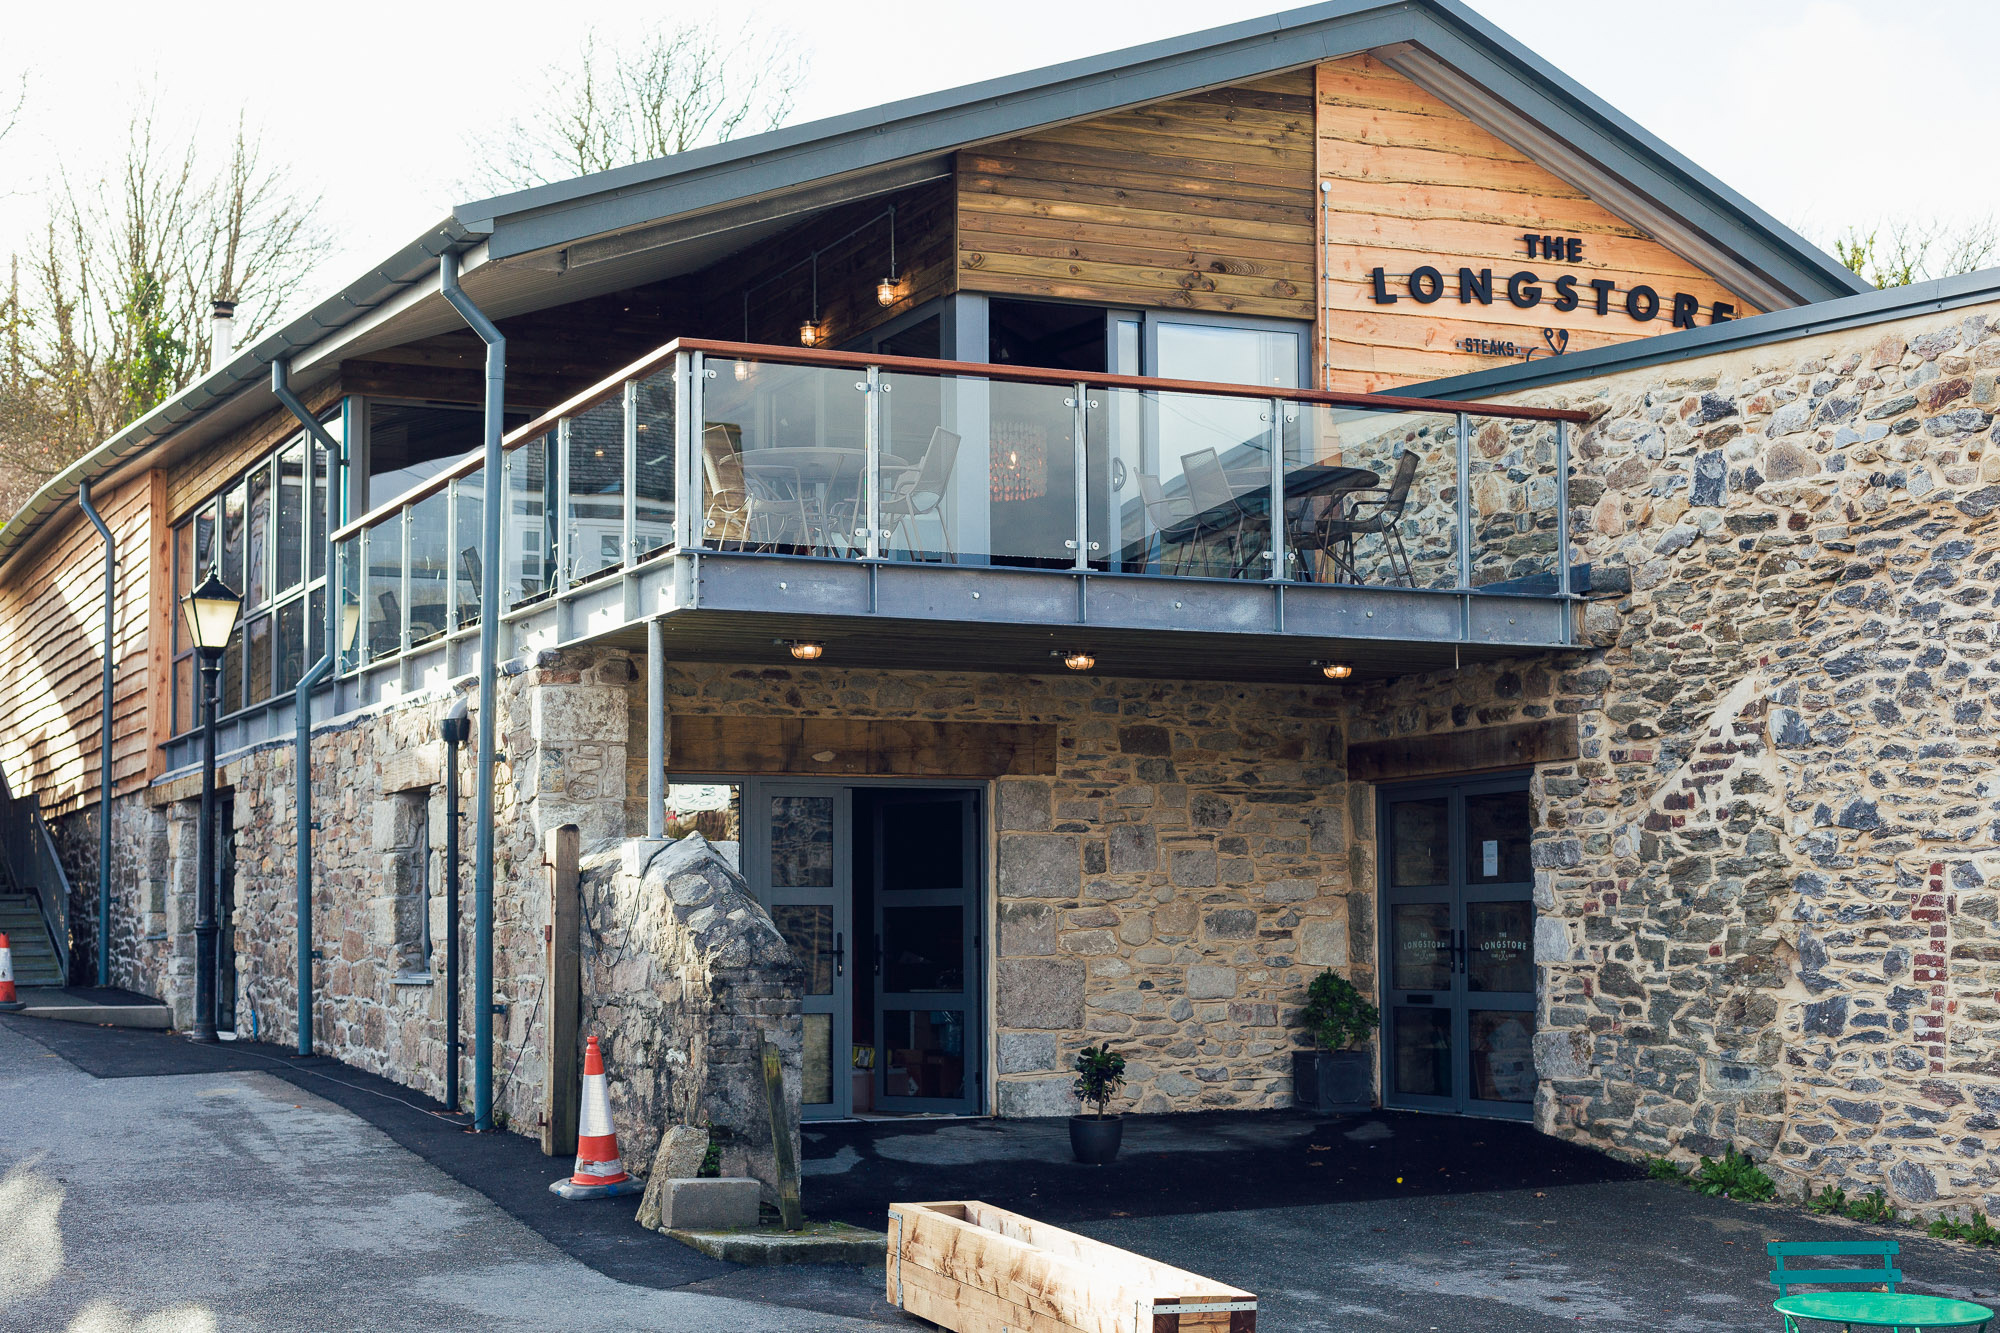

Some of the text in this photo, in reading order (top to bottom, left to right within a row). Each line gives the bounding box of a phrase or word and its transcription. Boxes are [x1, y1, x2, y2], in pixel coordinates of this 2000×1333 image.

[1523, 233, 1583, 263] THE
[1465, 337, 1515, 357] STEAKS
[1480, 940, 1527, 951] LONGSTORE
